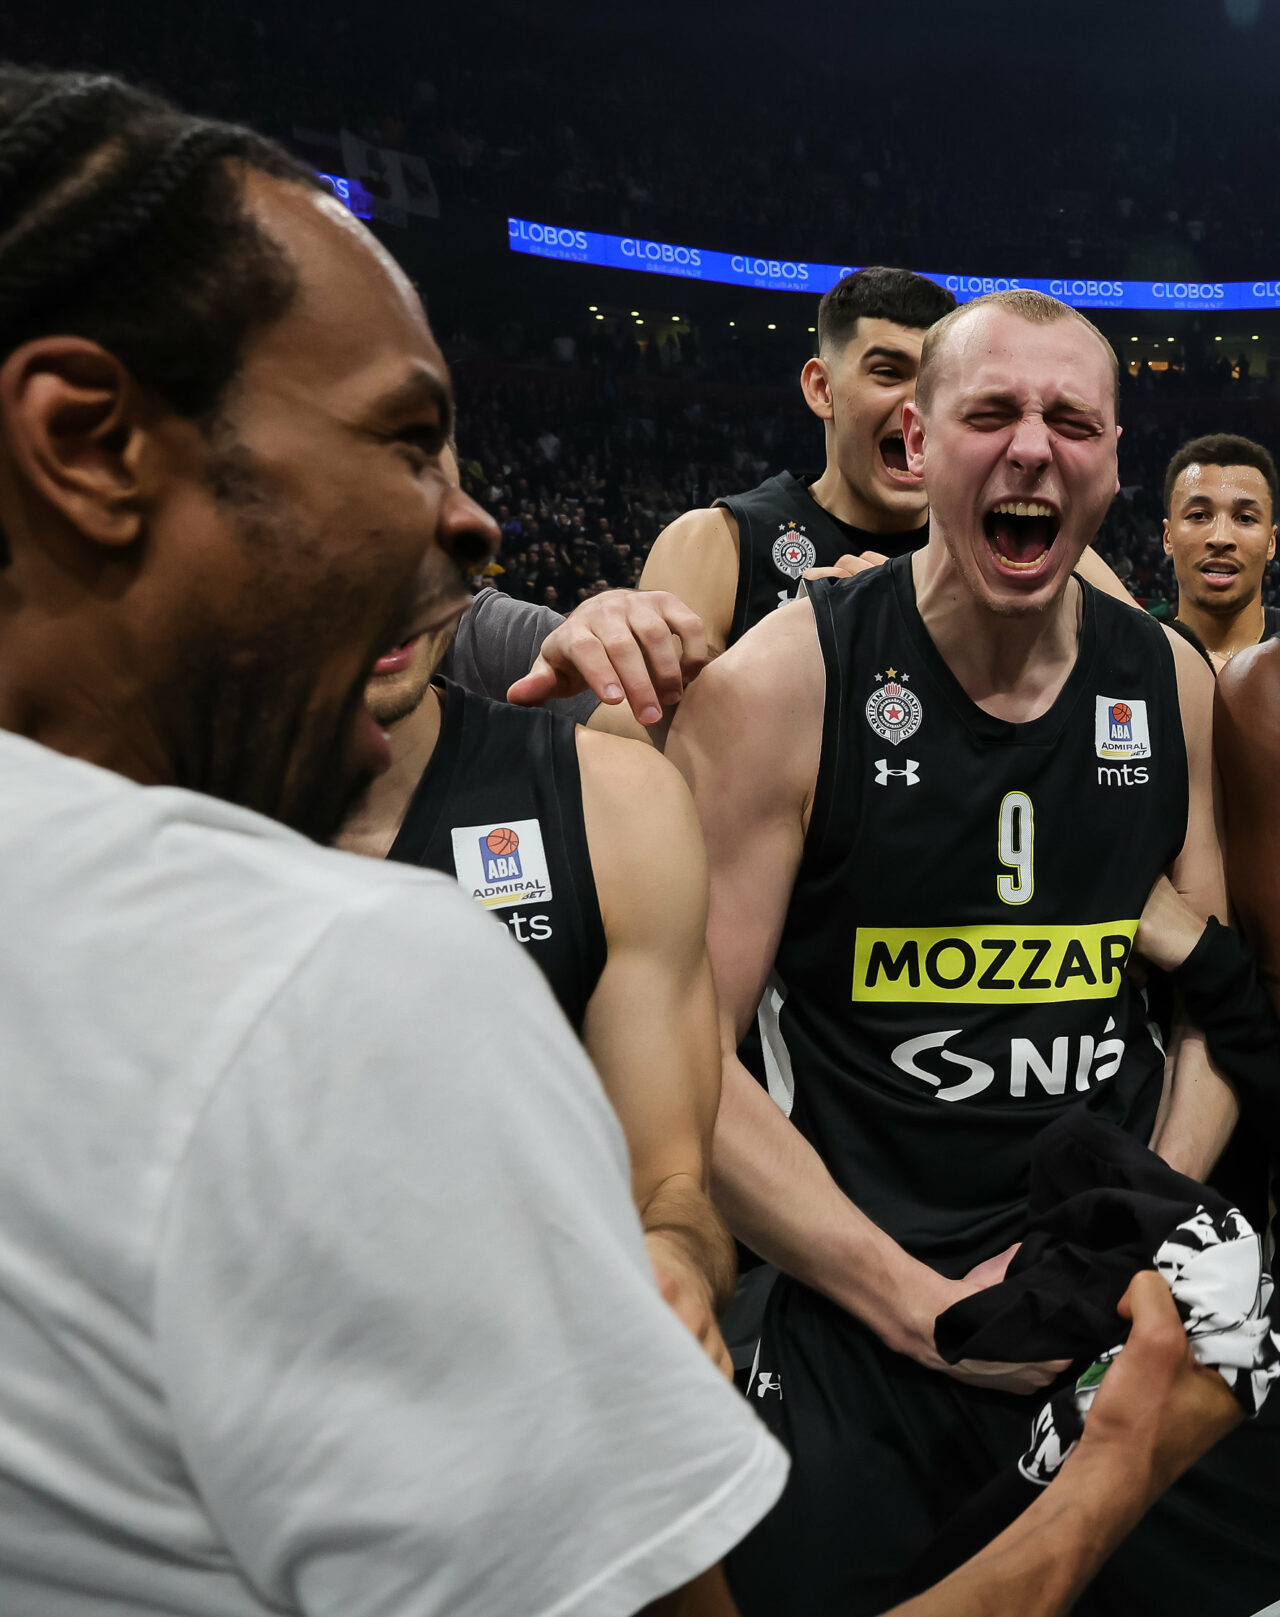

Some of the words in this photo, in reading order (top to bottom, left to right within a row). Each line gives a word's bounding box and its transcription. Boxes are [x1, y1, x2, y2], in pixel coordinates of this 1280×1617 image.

[620, 239, 702, 266] GLOBOS
[731, 256, 809, 280] GLOBOS
[1050, 280, 1124, 297] GLOBOS
[1152, 283, 1225, 299] GLOBOS
[1111, 724, 1130, 739] ABA
[1101, 742, 1147, 751] ADMIRAL
[1098, 764, 1149, 786] mts
[997, 791, 1034, 905] 9
[488, 857, 520, 880] ABA
[472, 879, 546, 899] ADMIRAL
